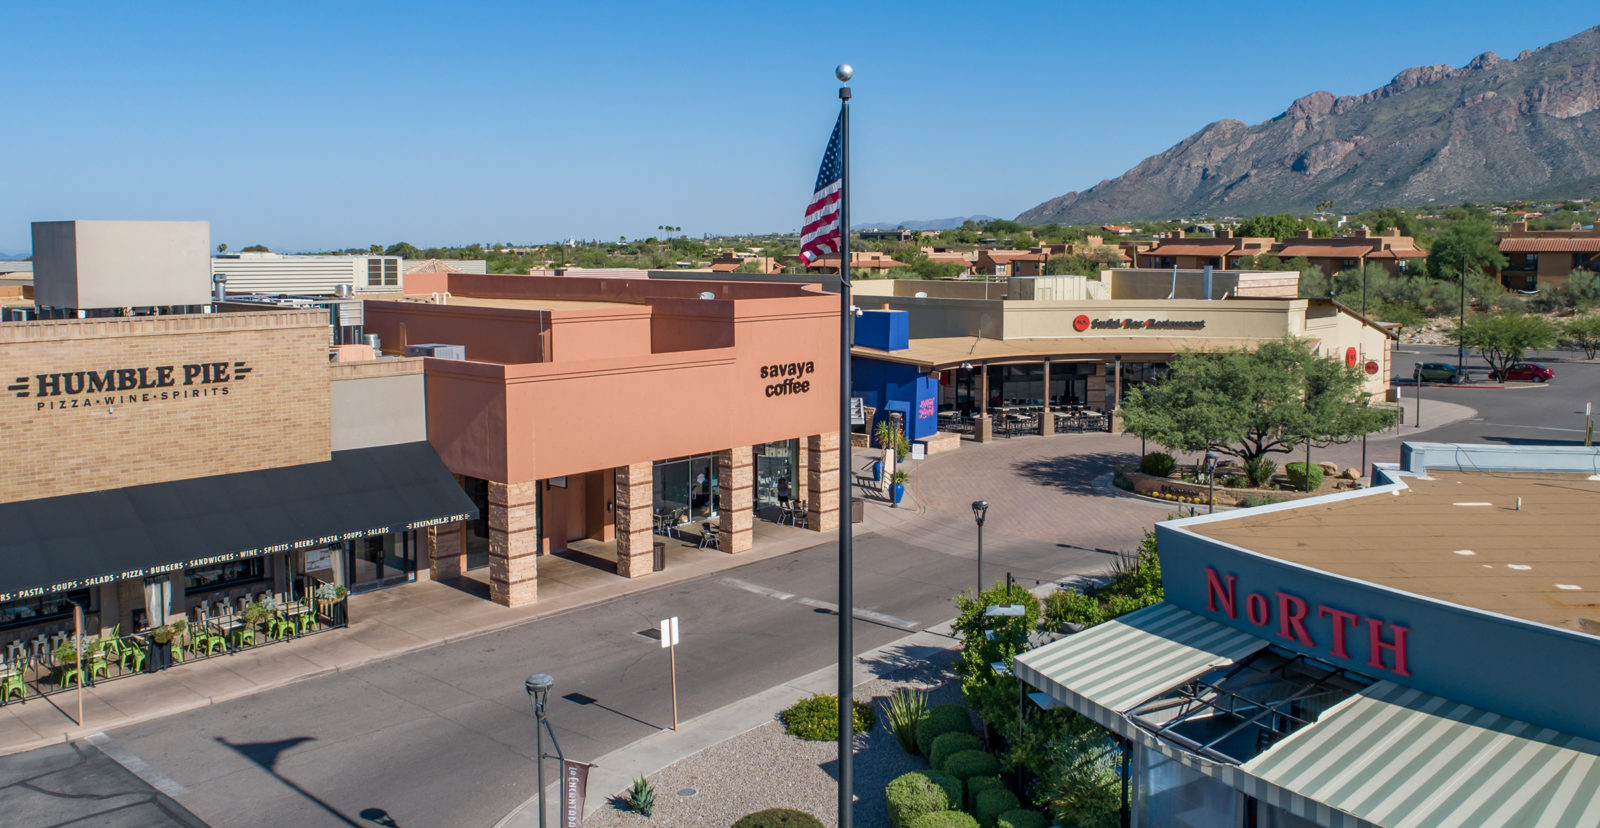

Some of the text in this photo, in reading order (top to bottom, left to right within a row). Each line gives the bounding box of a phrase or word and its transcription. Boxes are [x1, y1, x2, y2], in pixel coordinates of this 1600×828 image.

[36, 362, 230, 397] HUMBLE PIE
[760, 361, 814, 379] savaya
[37, 386, 230, 411] PIZZA WINE SPIRITS
[765, 378, 810, 398] coffee
[413, 514, 464, 529] HUMBLE PIE
[19, 587, 44, 598] PASTA
[51, 581, 78, 593] SOUPS
[84, 574, 114, 586] SALADS
[121, 569, 143, 580] PIZZA
[150, 562, 183, 575] BURGERS
[189, 553, 234, 568] SANDWICHES
[240, 548, 258, 558] WINE
[263, 543, 289, 554] SPIRITS
[295, 539, 314, 549] BEERS
[319, 535, 338, 544] PASTA
[343, 530, 363, 540] SOUPS
[367, 526, 390, 536] SALADS
